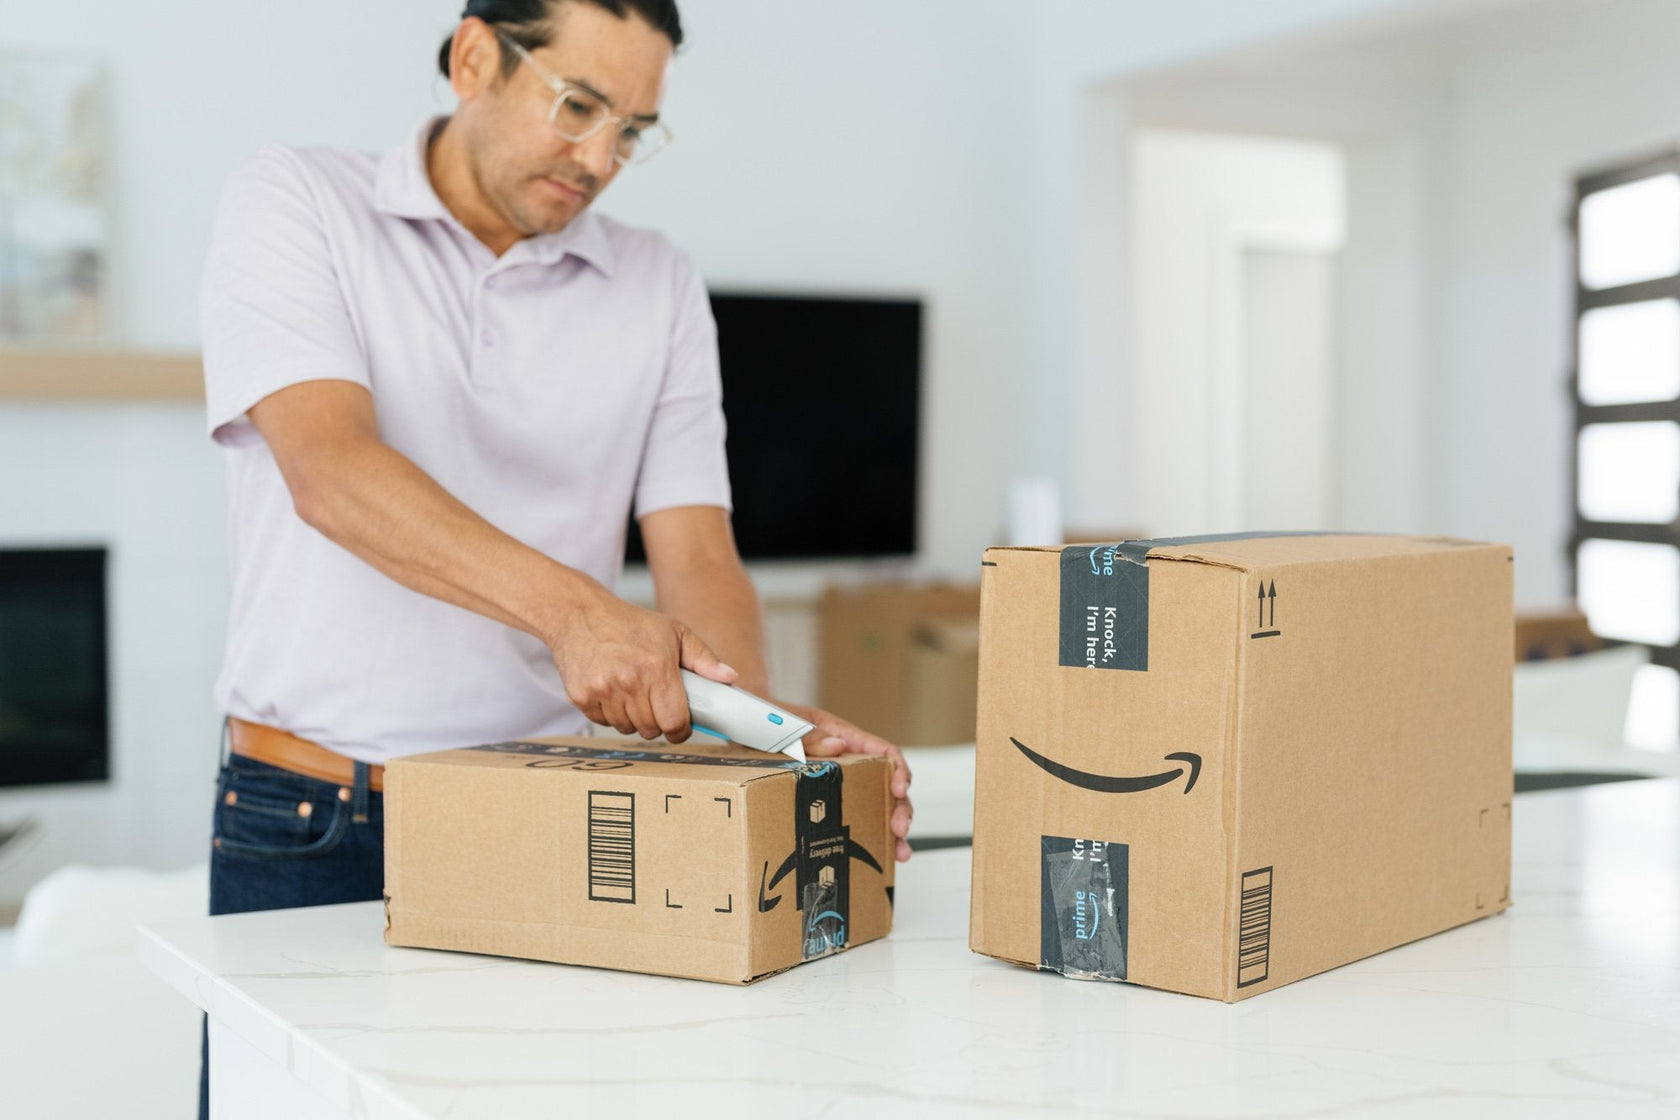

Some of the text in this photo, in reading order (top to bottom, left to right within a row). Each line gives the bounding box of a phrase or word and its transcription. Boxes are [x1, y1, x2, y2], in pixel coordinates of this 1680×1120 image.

[1087, 606, 1099, 632] I'm
[1102, 607, 1117, 663] Knock,
[809, 847, 832, 859] delivery
[1072, 890, 1088, 939] prime
